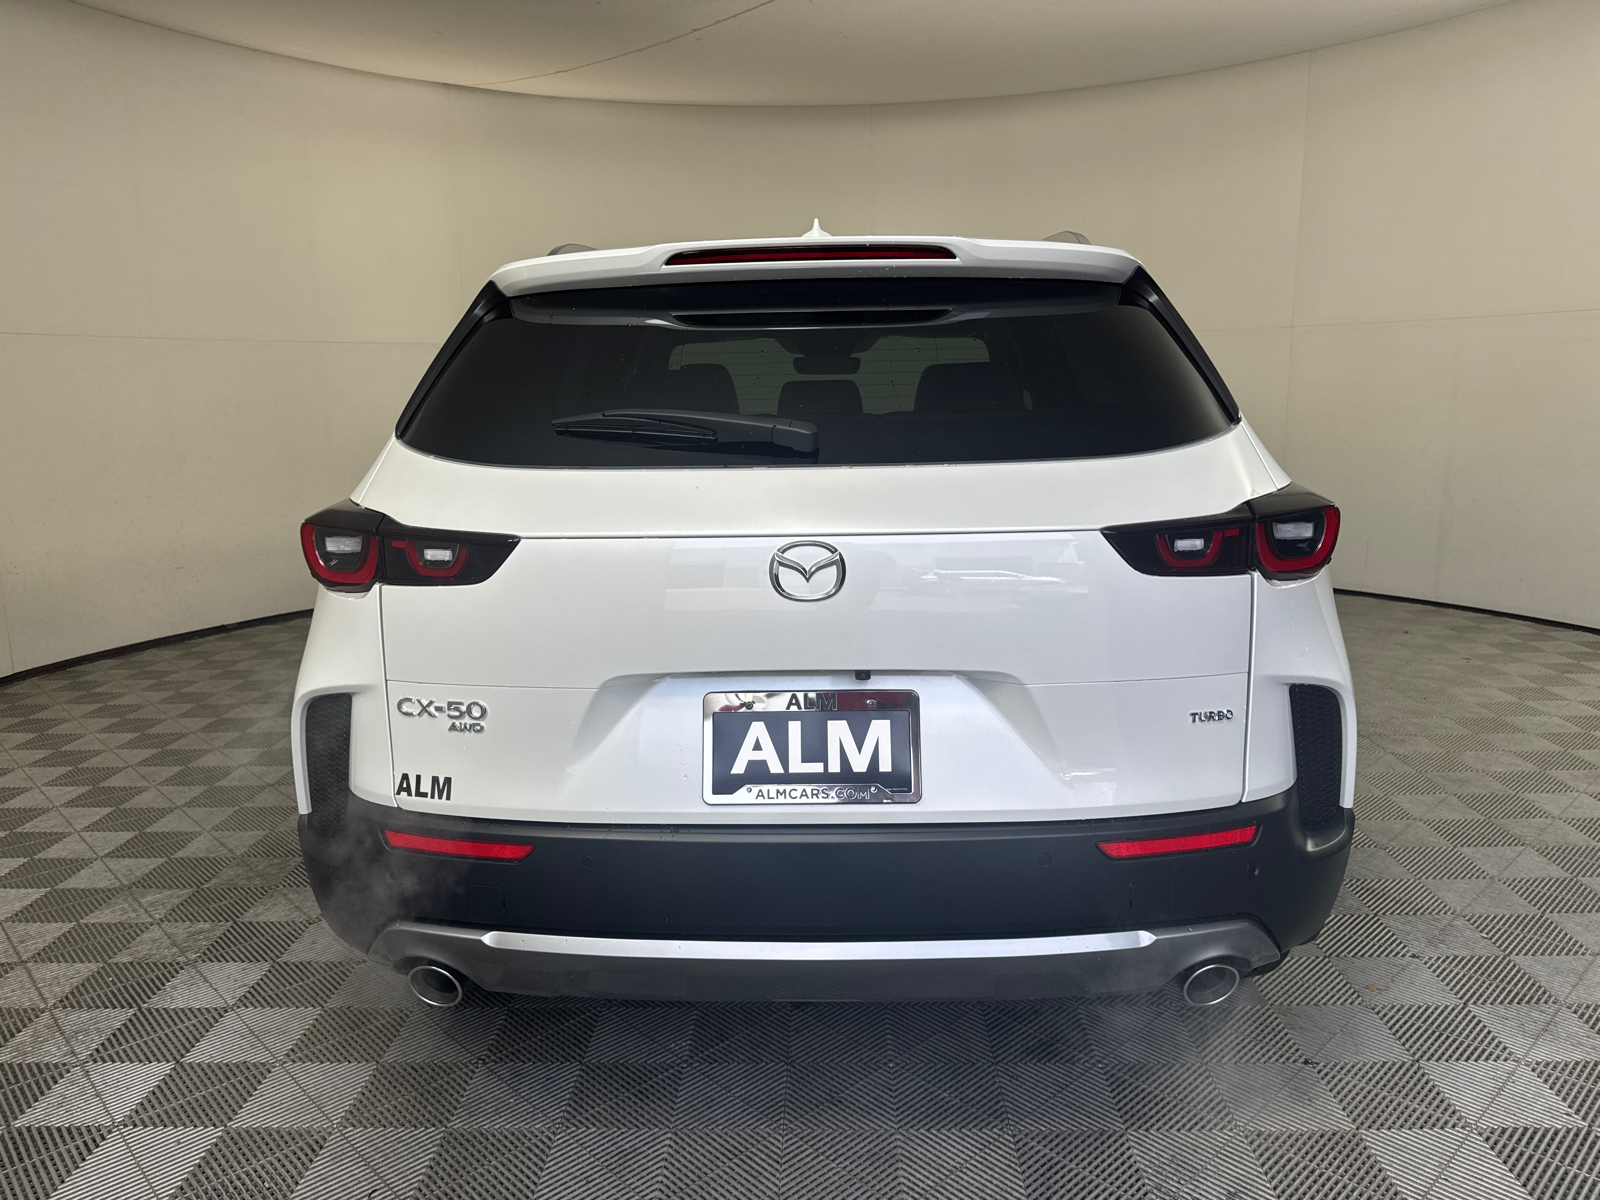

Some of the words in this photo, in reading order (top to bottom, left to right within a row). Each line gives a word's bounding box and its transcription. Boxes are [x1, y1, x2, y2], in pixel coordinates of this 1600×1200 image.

[397, 697, 487, 720] CX-50
[786, 693, 837, 710] ALM
[1189, 709, 1233, 723] TURBO
[448, 721, 484, 733] AWD
[730, 720, 892, 774] ALM
[396, 773, 452, 801] ALM
[755, 786, 870, 800] ALMCARS.COM
